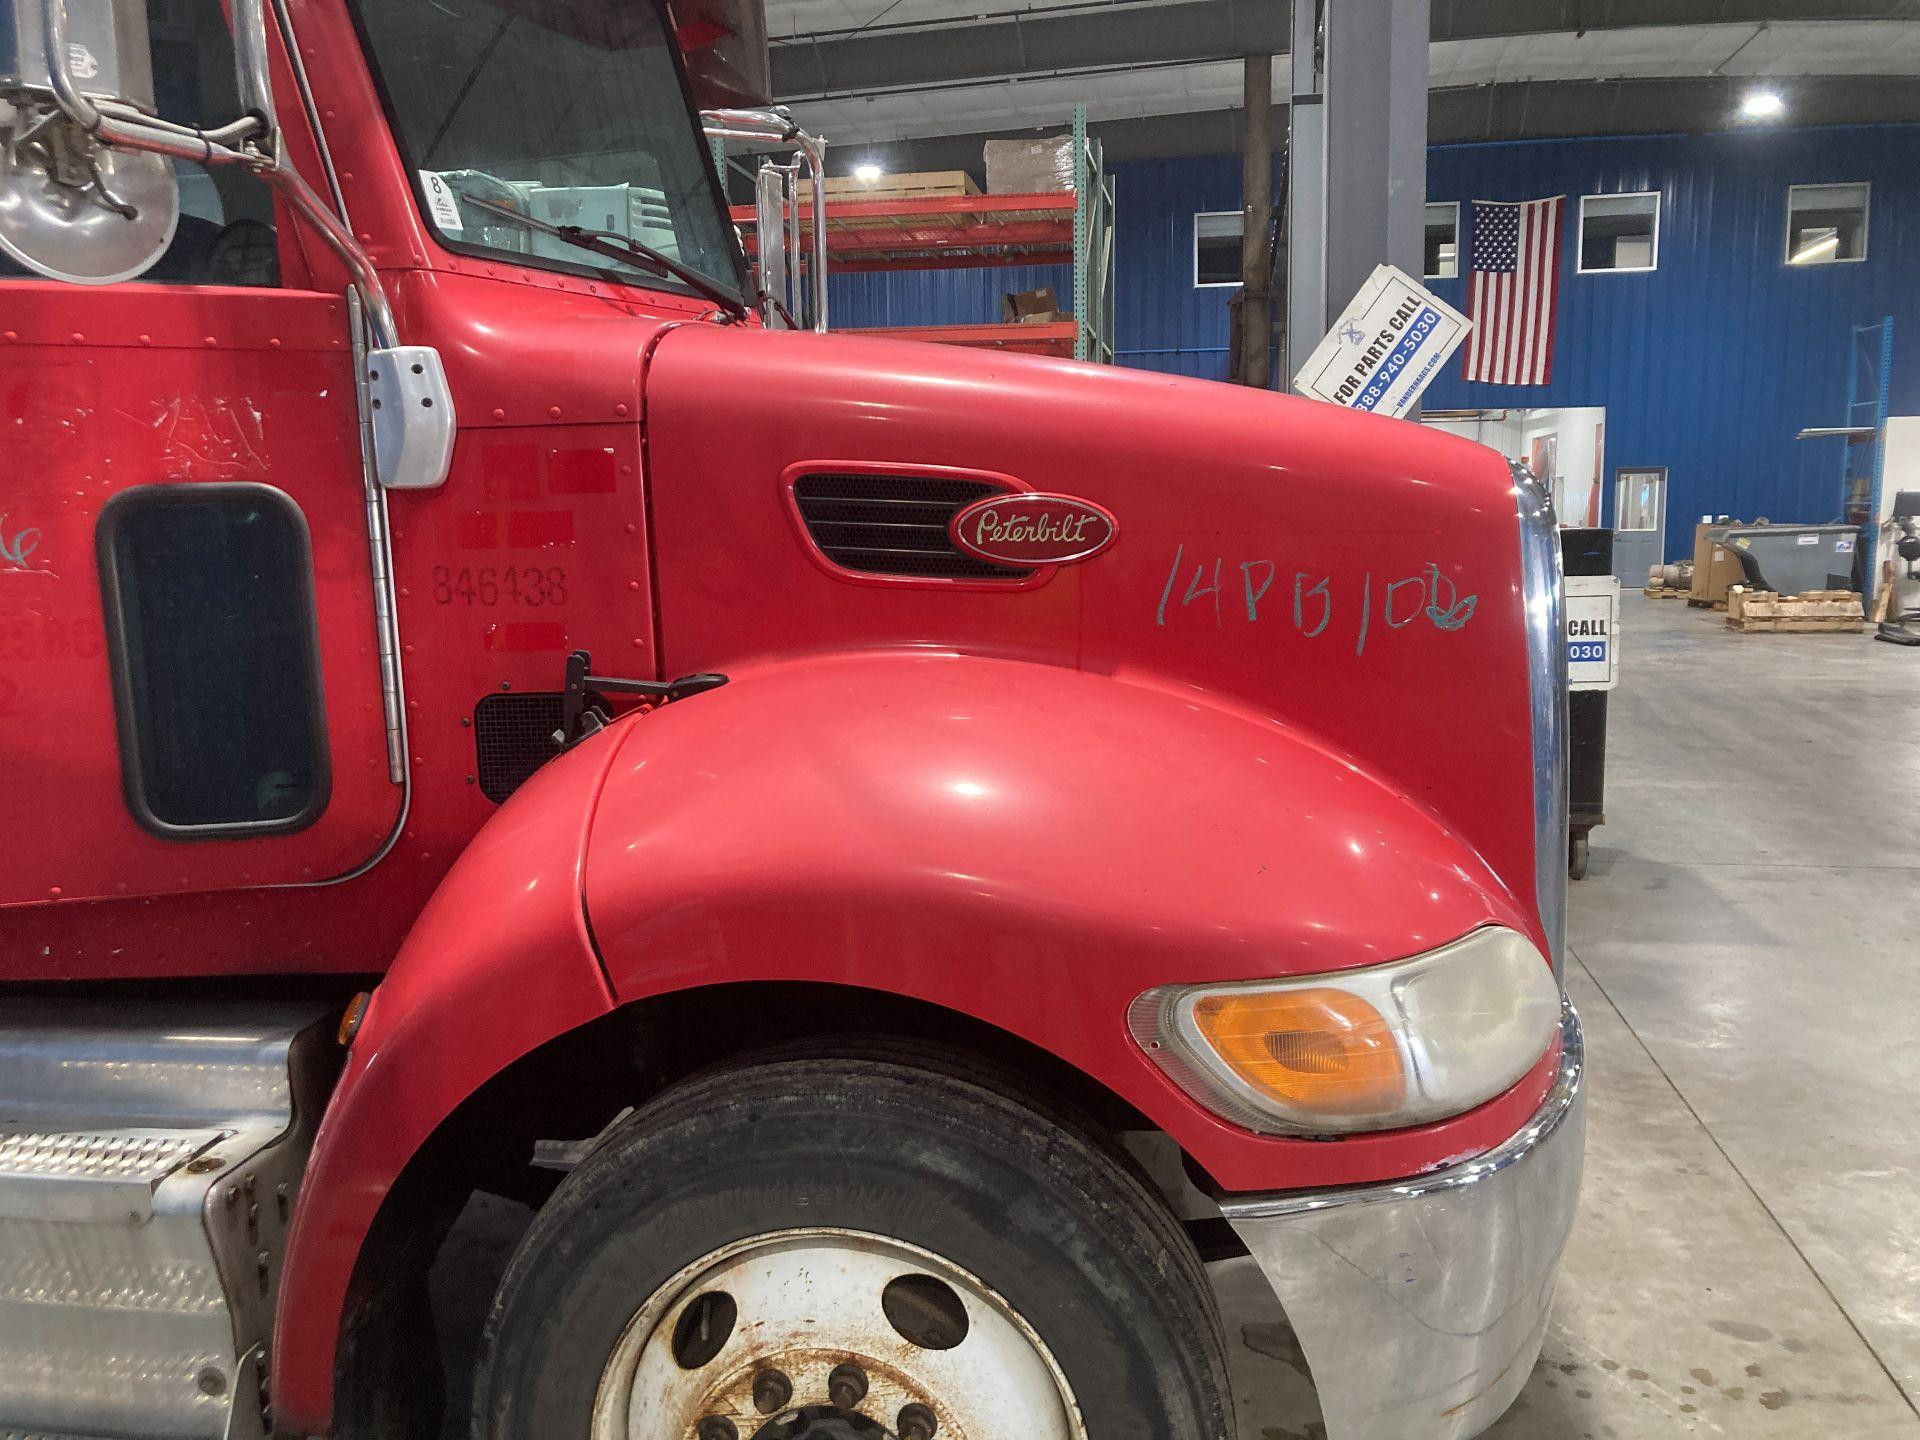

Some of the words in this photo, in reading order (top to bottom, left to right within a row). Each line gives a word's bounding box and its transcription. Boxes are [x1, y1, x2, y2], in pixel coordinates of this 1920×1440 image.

[430, 176, 442, 194] 8
[1333, 374, 1362, 405] FOR
[1354, 329, 1395, 377] PARTS
[1389, 295, 1422, 331] CALL
[976, 509, 1098, 545] Peterbilt
[1568, 619, 1607, 636] CALL
